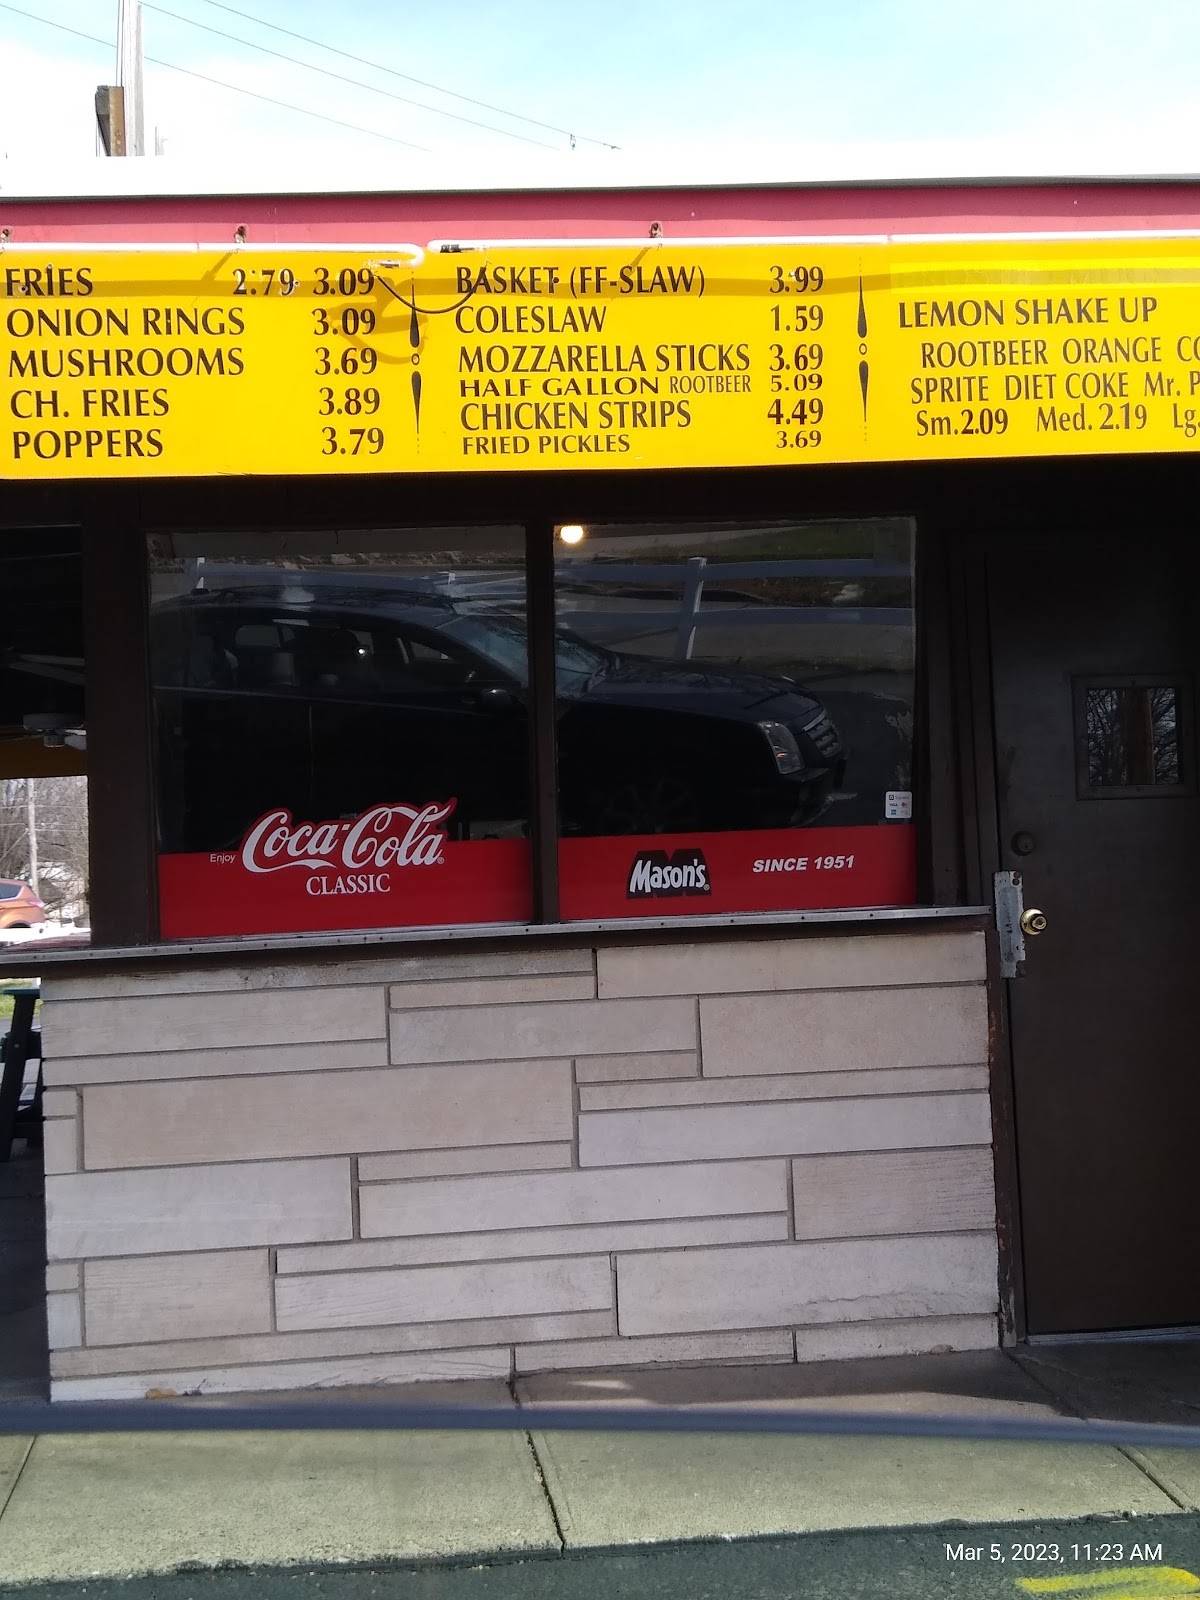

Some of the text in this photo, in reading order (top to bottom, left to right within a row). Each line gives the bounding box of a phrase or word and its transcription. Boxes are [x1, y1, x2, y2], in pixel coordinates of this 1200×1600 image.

[6, 267, 375, 297] FRIES 2.79 3.09
[456, 265, 825, 298] BASKET (FF-SLAW) 3.99
[6, 306, 377, 338] ONION RINGS 3.09
[455, 305, 824, 333] COLESLAW 1.59
[898, 297, 1158, 328] LEMON SHAKE UP
[8, 346, 378, 378] MUSHROOMS 3.69
[458, 343, 824, 373] MOZZARELLA STICKS 3.69
[921, 339, 1049, 368] ROOTBEER
[1062, 337, 1162, 364] ORANGE
[460, 374, 823, 397] HALF GALLON ROOTBEER 5.09
[911, 376, 989, 405] SPRITE
[1005, 374, 1057, 401] DIET
[1065, 372, 1129, 398] COKE
[1144, 371, 1181, 397] Mr.
[10, 386, 381, 419] CH. FRIES 3.89
[460, 398, 824, 430] CHICKEN STRIPS 4.49
[12, 426, 385, 459] POPPERS 3.79
[462, 430, 823, 455] FRIED PICKLES 3.69
[209, 805, 451, 873] Enjoy Coca-Cola
[629, 858, 707, 893] Mason's
[753, 855, 855, 873] SINCE 1951
[306, 873, 391, 895] CLASSIC
